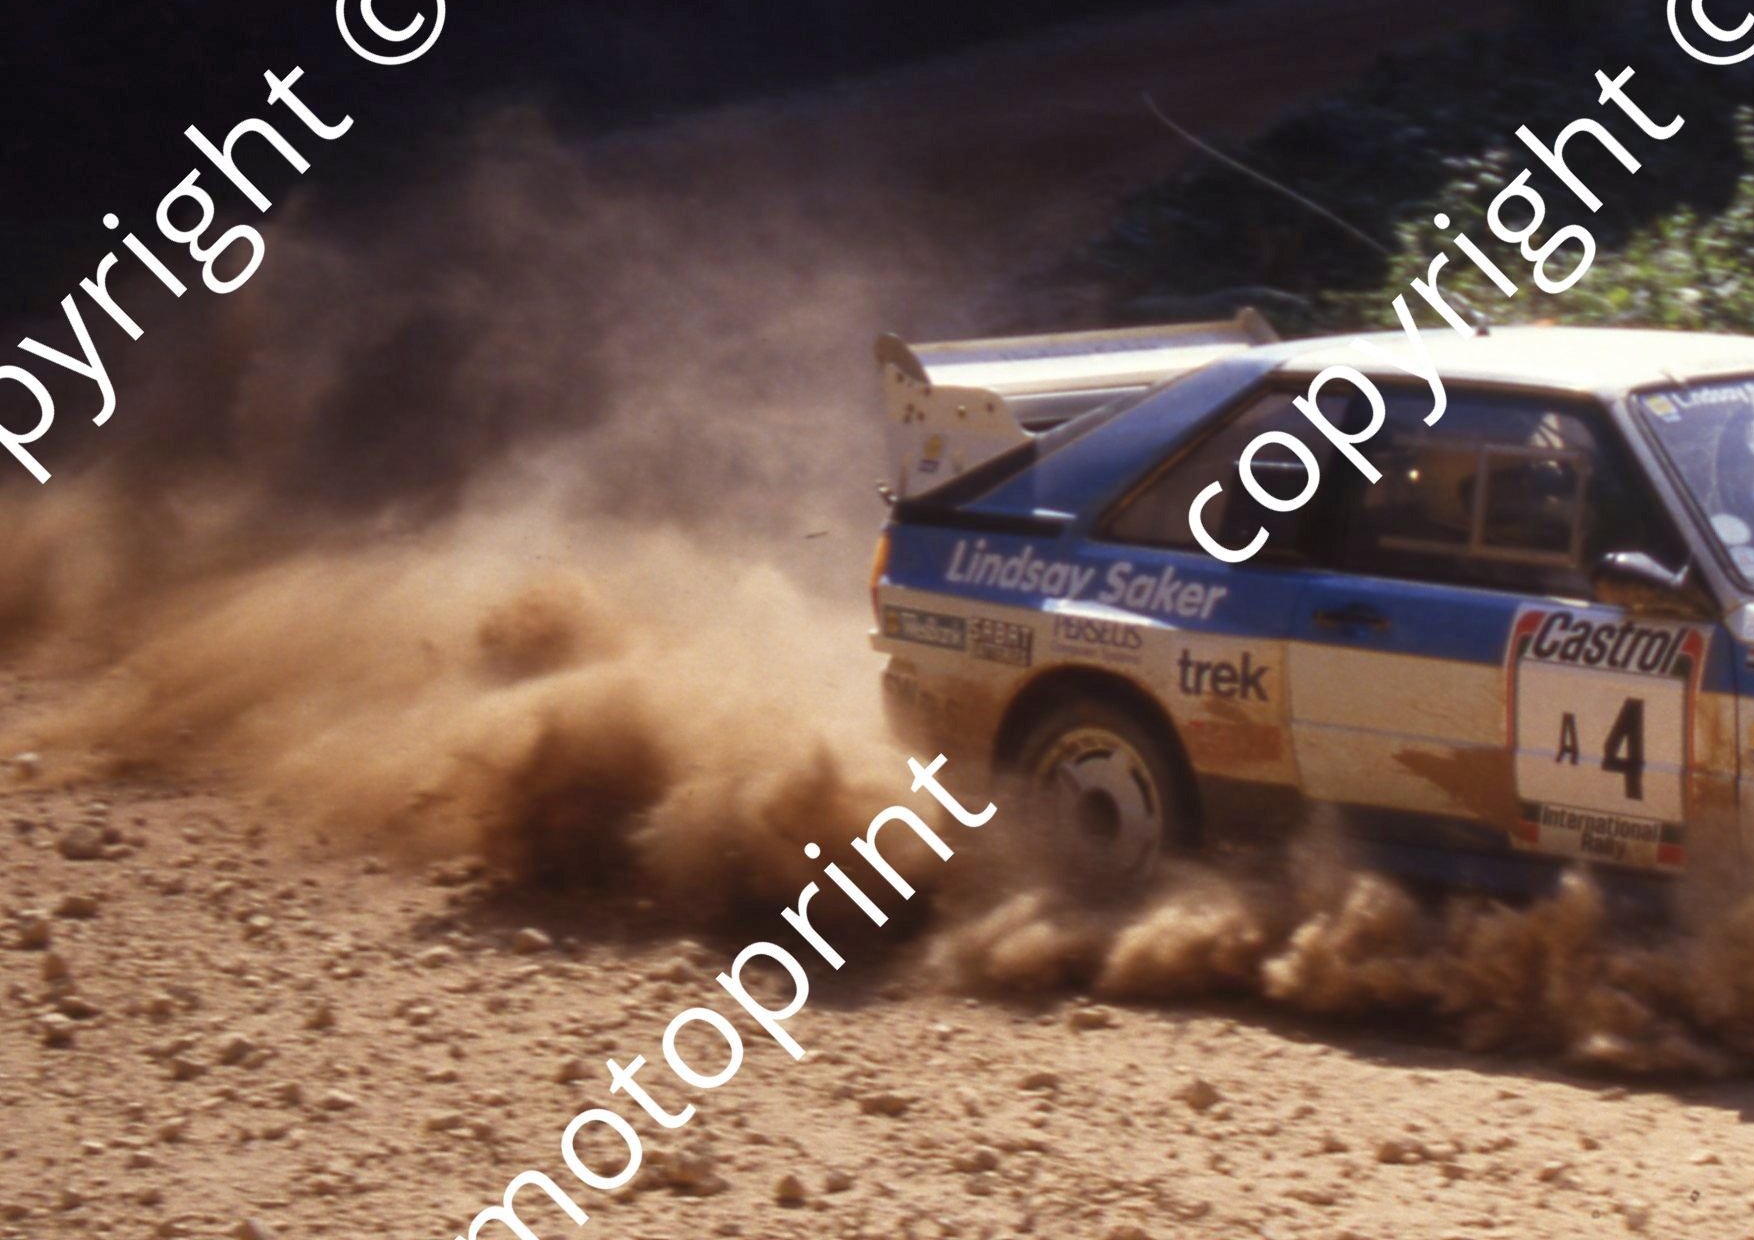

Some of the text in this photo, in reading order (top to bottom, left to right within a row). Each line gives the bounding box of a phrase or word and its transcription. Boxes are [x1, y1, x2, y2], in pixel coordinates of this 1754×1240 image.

[946, 539, 1228, 619] Lindsay Saker
[1532, 611, 1688, 674] Castrol
[1177, 648, 1271, 702] trek
[1555, 697, 1645, 801] A 4
[1541, 806, 1661, 843] International
